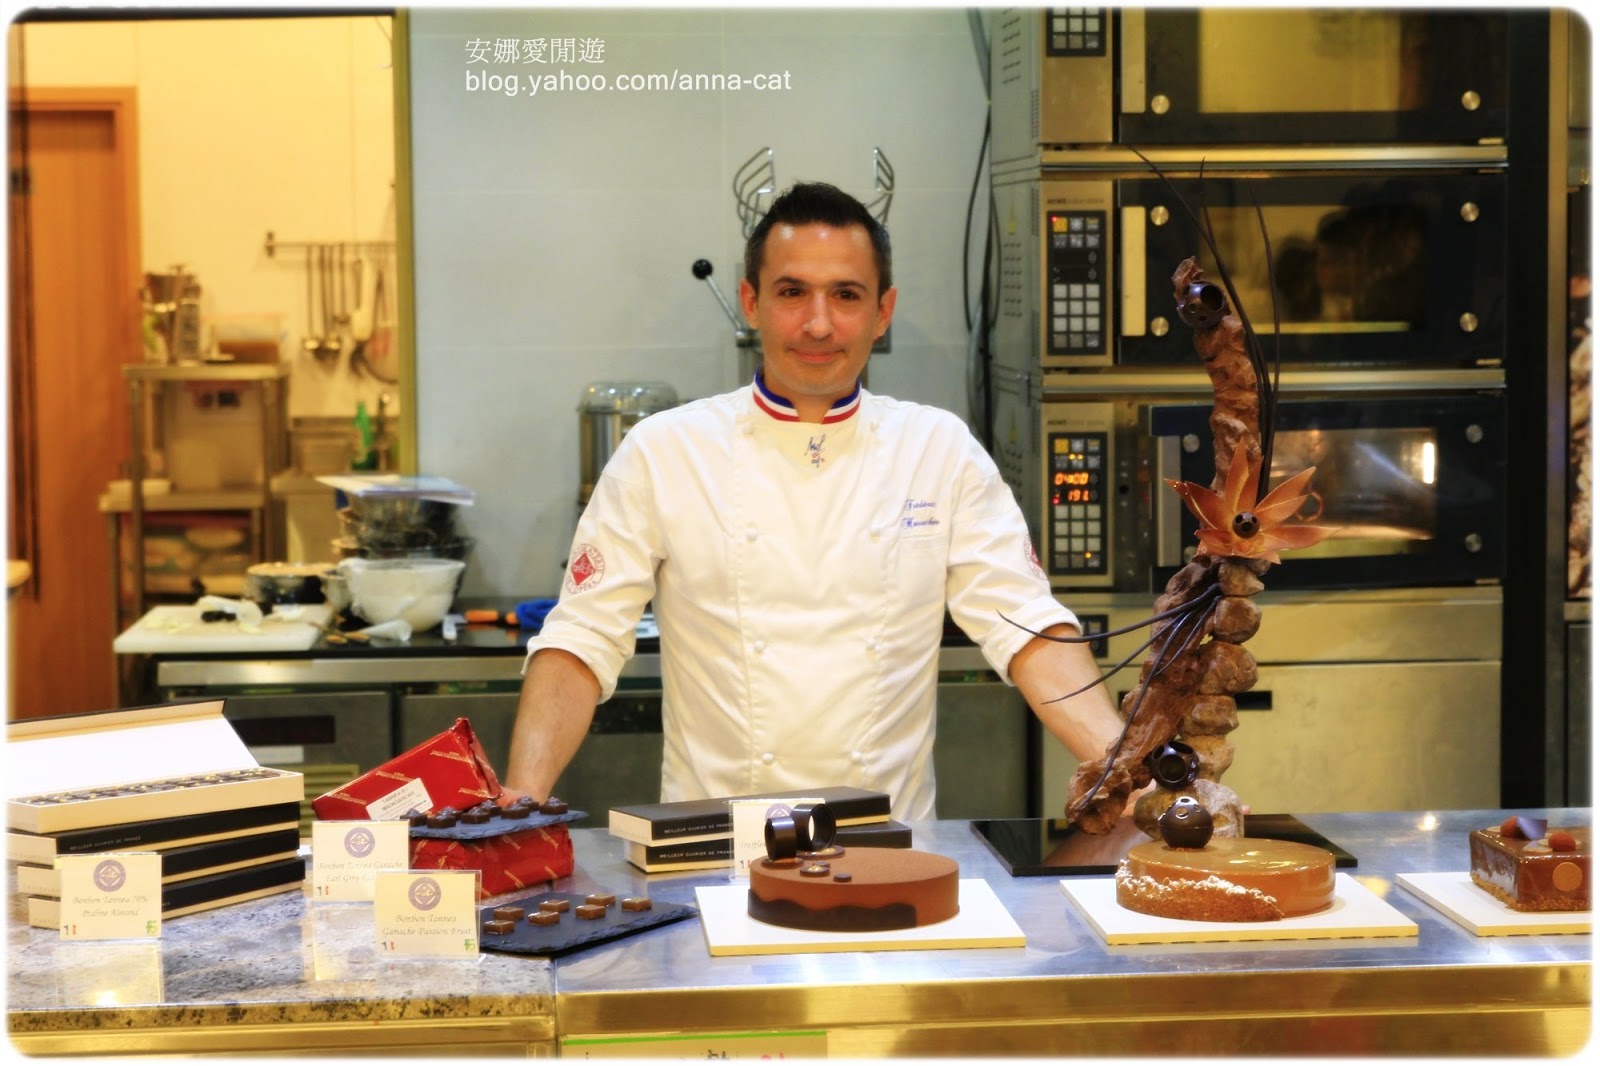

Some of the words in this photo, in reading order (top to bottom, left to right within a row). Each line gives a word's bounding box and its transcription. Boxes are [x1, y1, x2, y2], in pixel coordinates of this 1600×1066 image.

[395, 914, 426, 923] Bonbon
[382, 927, 416, 937] Ganache
[417, 927, 449, 936] Passion
[450, 927, 472, 935] Fruit
